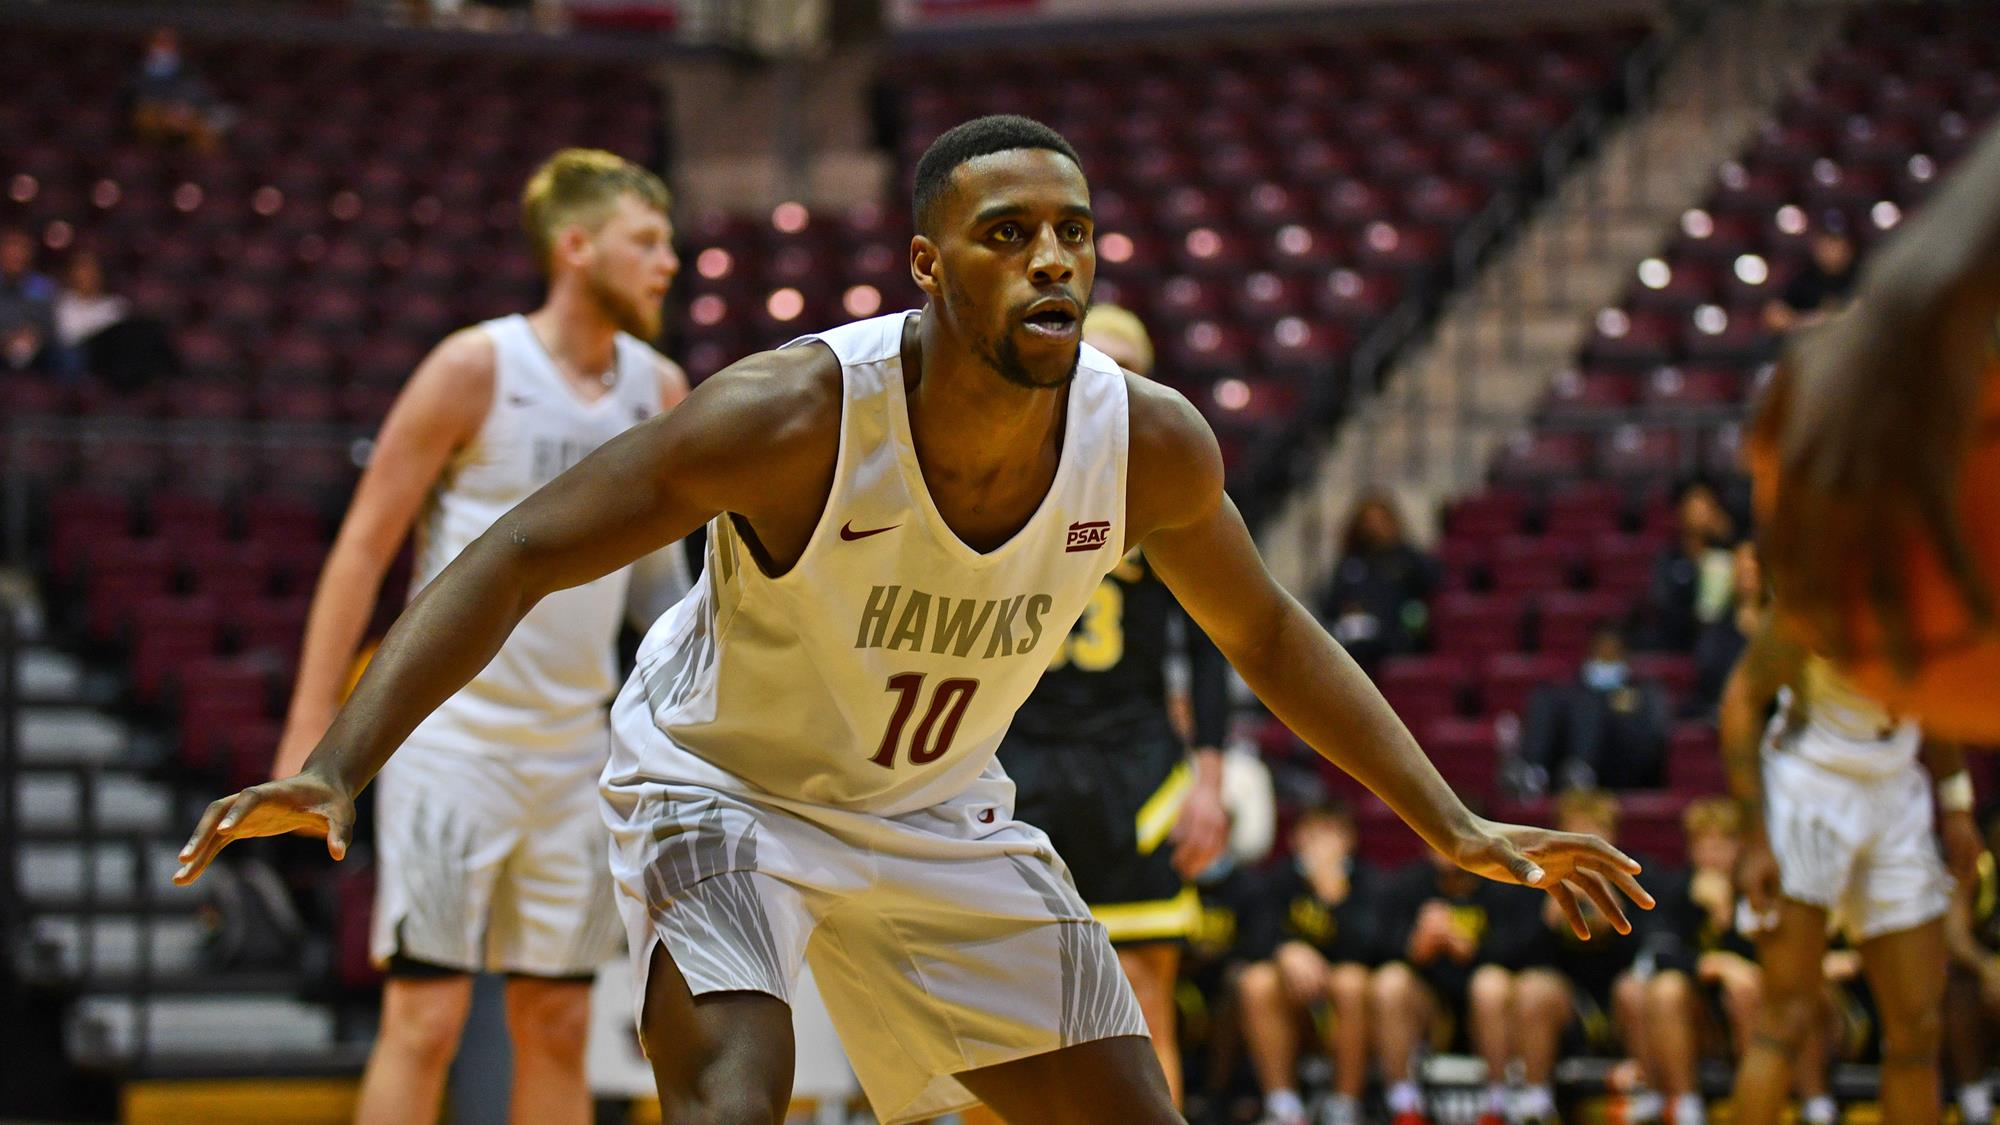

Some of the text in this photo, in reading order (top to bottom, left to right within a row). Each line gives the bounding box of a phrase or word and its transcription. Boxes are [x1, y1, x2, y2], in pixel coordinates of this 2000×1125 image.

[1066, 525, 1111, 547] PSAC
[854, 585, 1053, 659] HAWKS
[867, 672, 981, 770] 10
